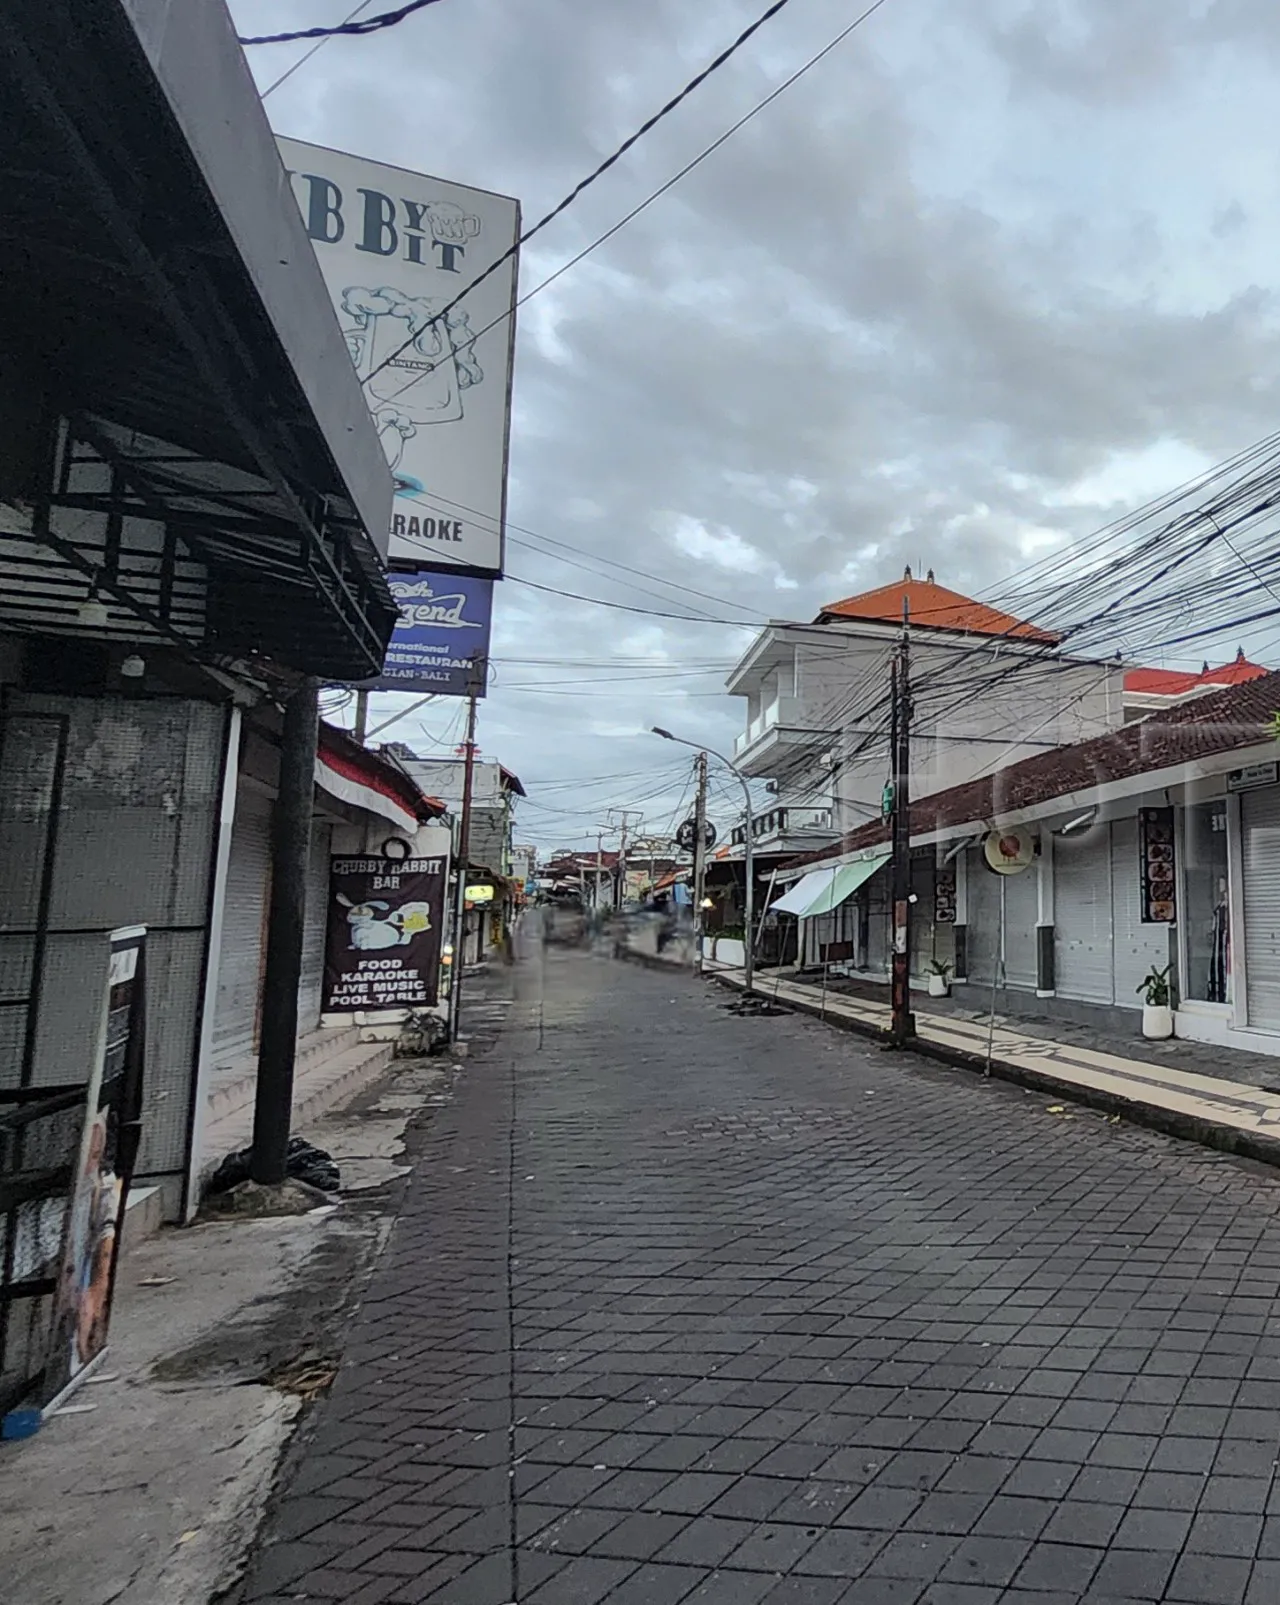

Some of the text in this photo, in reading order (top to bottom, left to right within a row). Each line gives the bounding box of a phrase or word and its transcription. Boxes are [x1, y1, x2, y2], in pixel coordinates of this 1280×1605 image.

[393, 513, 463, 542] RAOKE
[394, 594, 483, 629] gend
[387, 642, 450, 654] ernational
[385, 652, 473, 669] RESTAURAN
[332, 860, 387, 875] CHUBBY
[373, 877, 400, 890] BAR
[358, 959, 403, 971] FOOD
[341, 969, 419, 982] KARAOKE
[333, 981, 425, 995] LIVE MUSIC
[330, 991, 427, 1007] POOL TABLE
